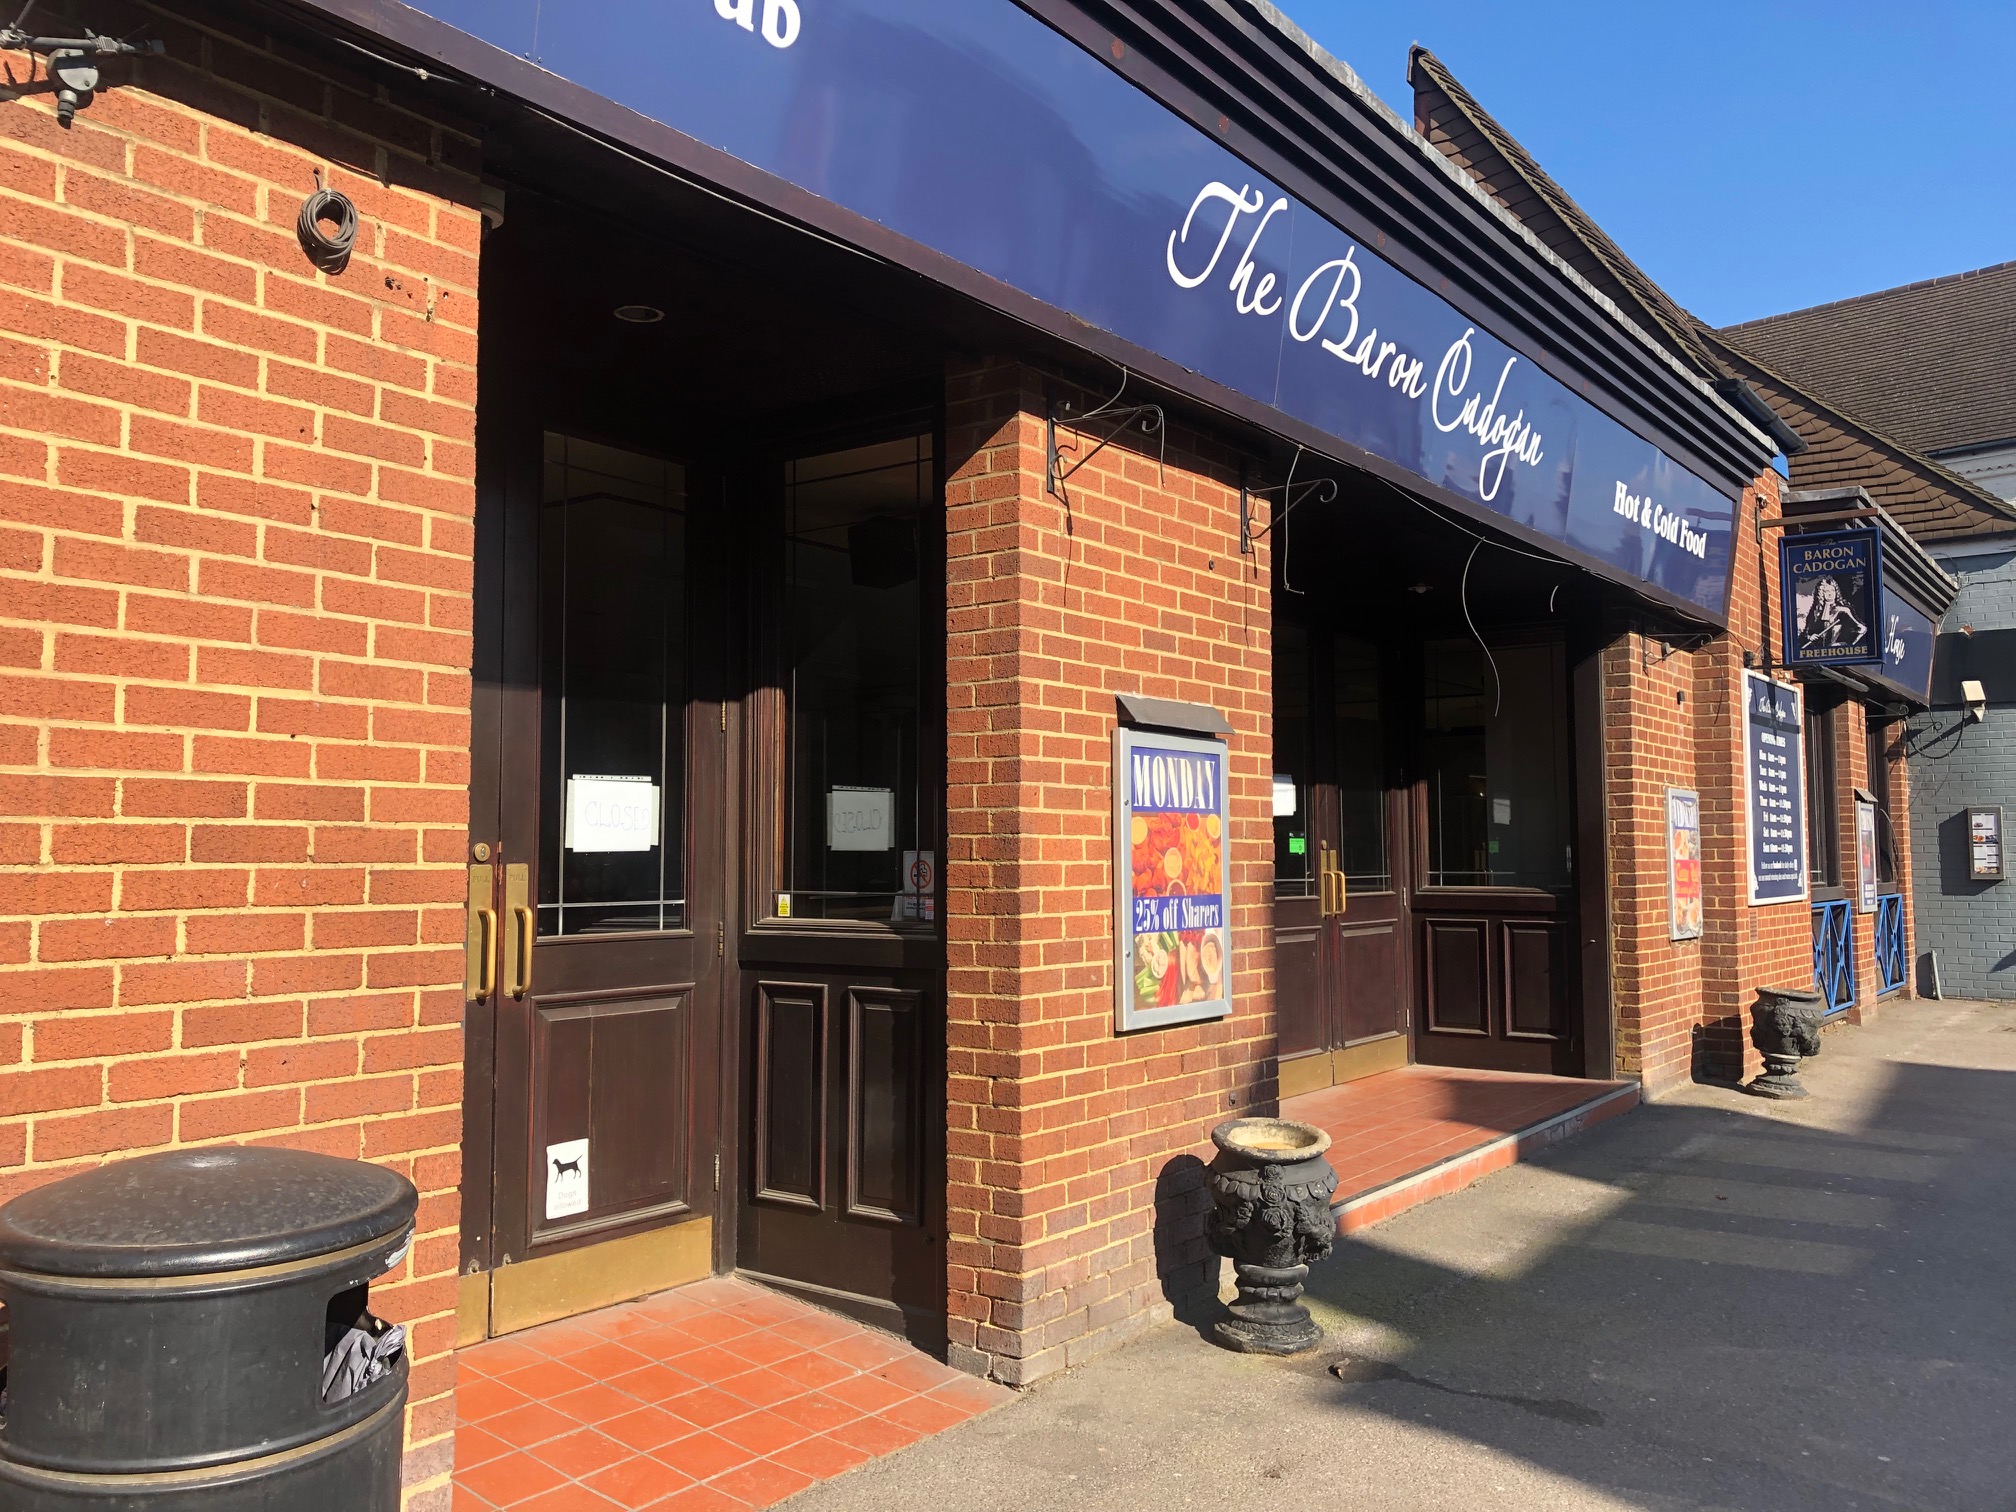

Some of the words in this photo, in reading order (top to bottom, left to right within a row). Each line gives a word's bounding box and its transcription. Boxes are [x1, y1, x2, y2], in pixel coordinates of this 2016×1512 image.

[1167, 181, 1288, 316] The
[1289, 246, 1427, 398] Baron
[1432, 327, 1543, 501] Cadogan
[1613, 480, 1640, 522] Hot
[1641, 496, 1652, 529] &
[1653, 504, 1680, 544] Cold
[1679, 519, 1707, 559] Food
[1793, 557, 1866, 574] CADOGAN
[1804, 546, 1854, 561] BARON
[1799, 645, 1868, 658] FREEHOUSE
[1132, 754, 1216, 810] MONDAY
[584, 800, 650, 831] CLOSED
[1136, 898, 1160, 932] 25%
[1163, 898, 1179, 931] off
[1181, 898, 1220, 929] Sharers
[554, 1199, 582, 1211] allowed
[558, 1190, 577, 1200] Dogs
